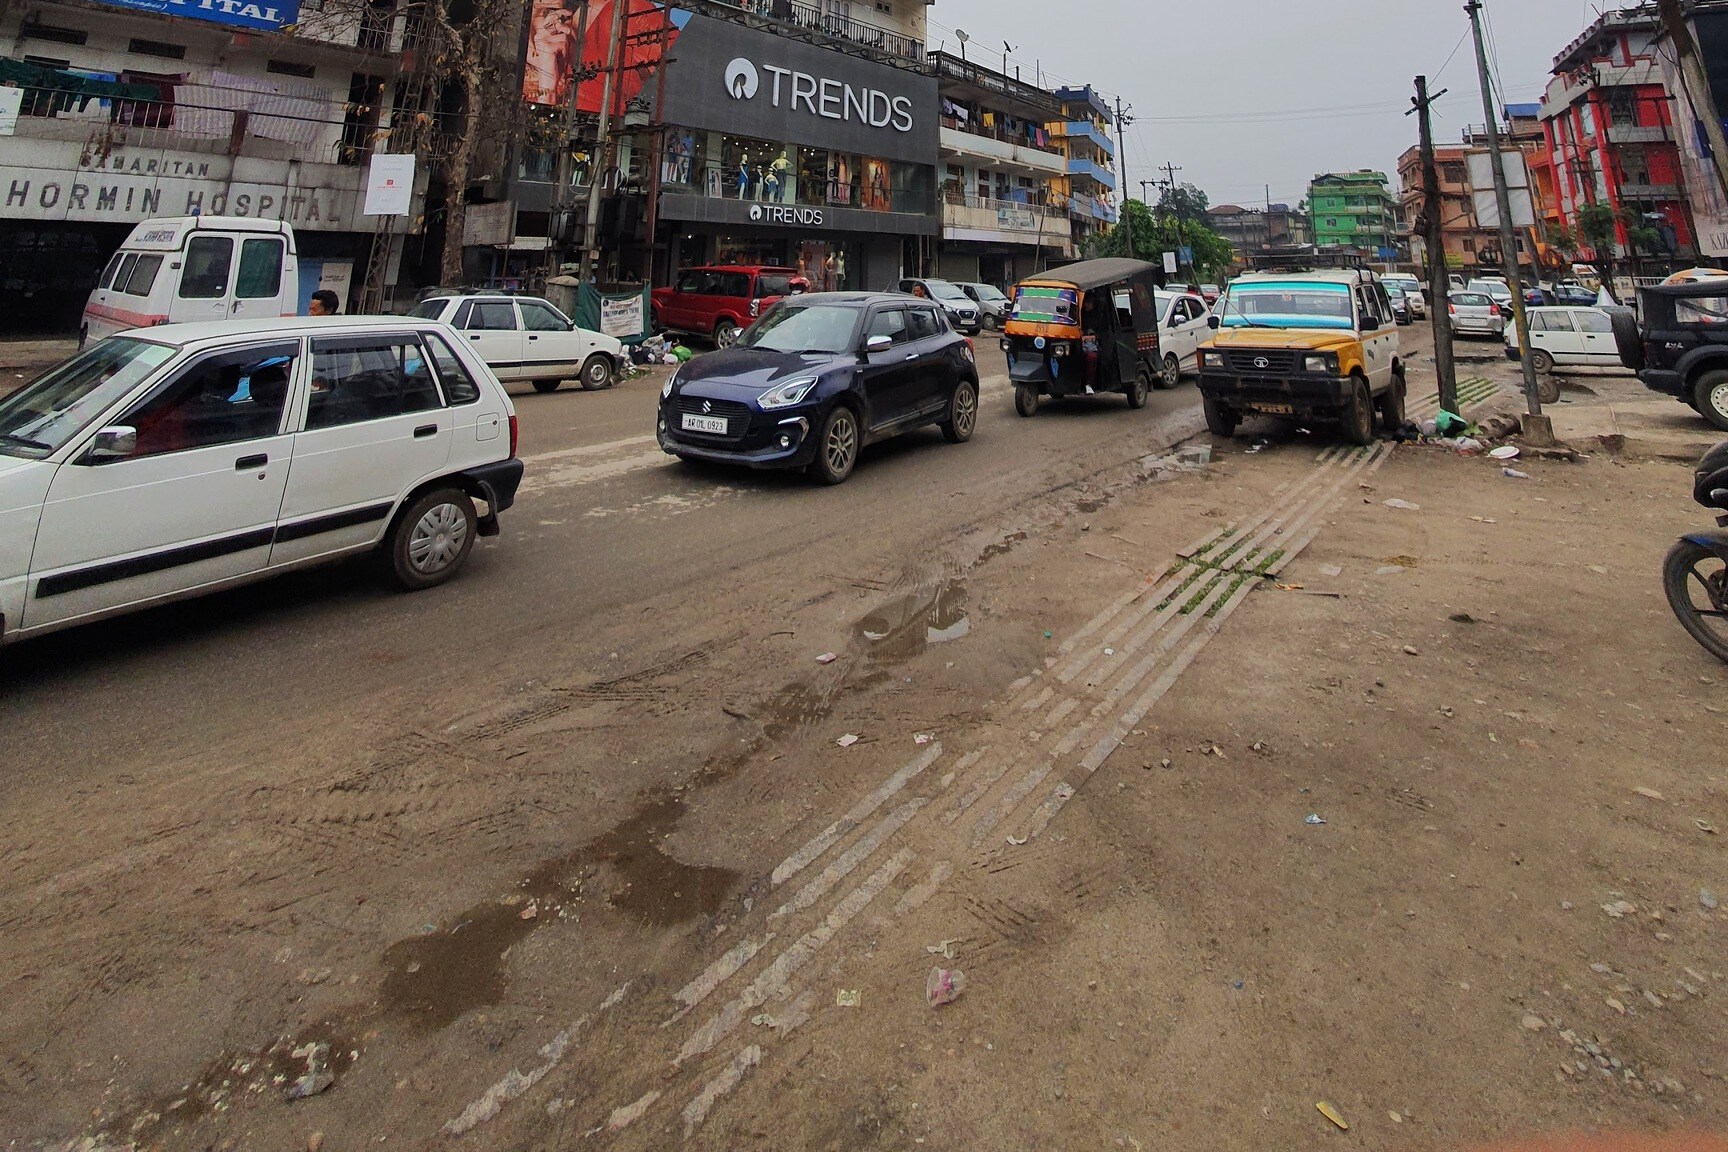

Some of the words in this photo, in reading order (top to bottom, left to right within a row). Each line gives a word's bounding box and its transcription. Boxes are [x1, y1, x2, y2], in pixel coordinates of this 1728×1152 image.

[762, 64, 913, 132] TRENDS
[80, 150, 209, 177] SAMARITAN
[6, 179, 161, 214] HORMIN
[185, 190, 340, 223] HOSPITAL
[763, 205, 823, 225] TRENDS
